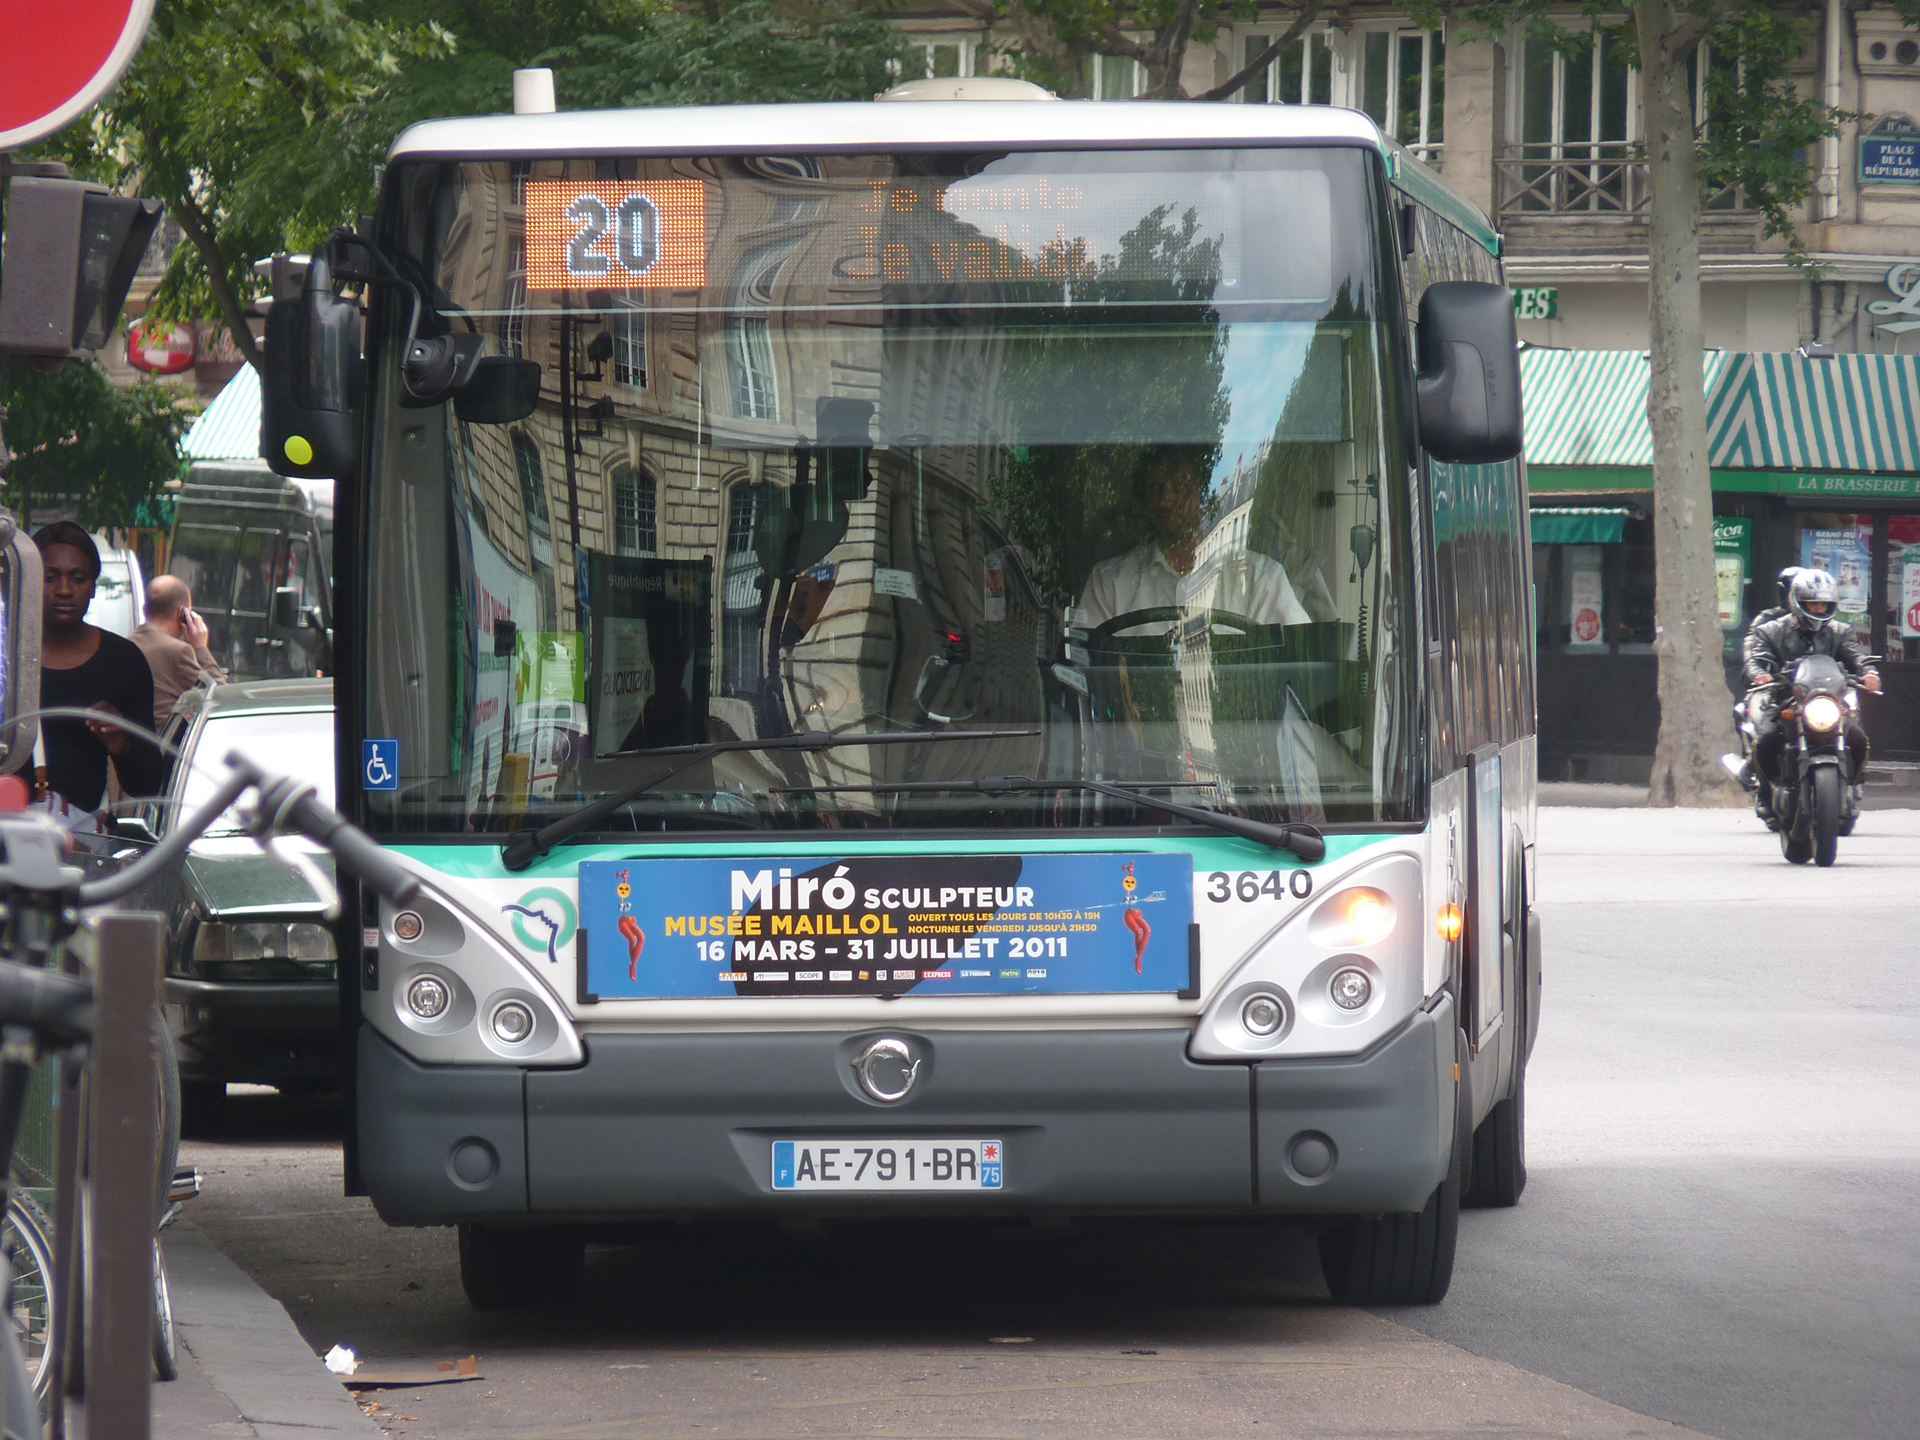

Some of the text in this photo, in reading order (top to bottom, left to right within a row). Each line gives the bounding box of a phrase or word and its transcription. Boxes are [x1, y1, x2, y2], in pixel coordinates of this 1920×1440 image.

[1880, 144, 1914, 155] PLACE
[1882, 155, 1911, 166] DE LA
[860, 178, 1084, 213] Je monte
[565, 192, 661, 277] 20
[848, 223, 1098, 280] Je valide
[1798, 478, 1817, 489] LA
[1824, 479, 1909, 492] BRASSERIE
[730, 864, 1035, 911] Miró SCULPTEUR
[1207, 869, 1313, 903] 3640
[664, 911, 898, 937] MUSÉE MAILLOL
[908, 914, 947, 922] OUVERT
[949, 913, 975, 921] TOUS
[977, 913, 994, 921] LES
[996, 913, 1027, 921] JOURS
[1029, 912, 1042, 920] DE
[908, 925, 960, 933] NOCTURNE
[962, 925, 974, 933] LE
[976, 924, 1024, 933] VENDREDI
[1026, 922, 1067, 933] JUSQU'À
[696, 940, 725, 961] 16
[735, 939, 816, 961] MARS
[847, 939, 875, 960] 31
[883, 938, 999, 960] JUILLET
[1008, 937, 1068, 958] 2011
[781, 1148, 1000, 1182] F AE-791-BR 75
